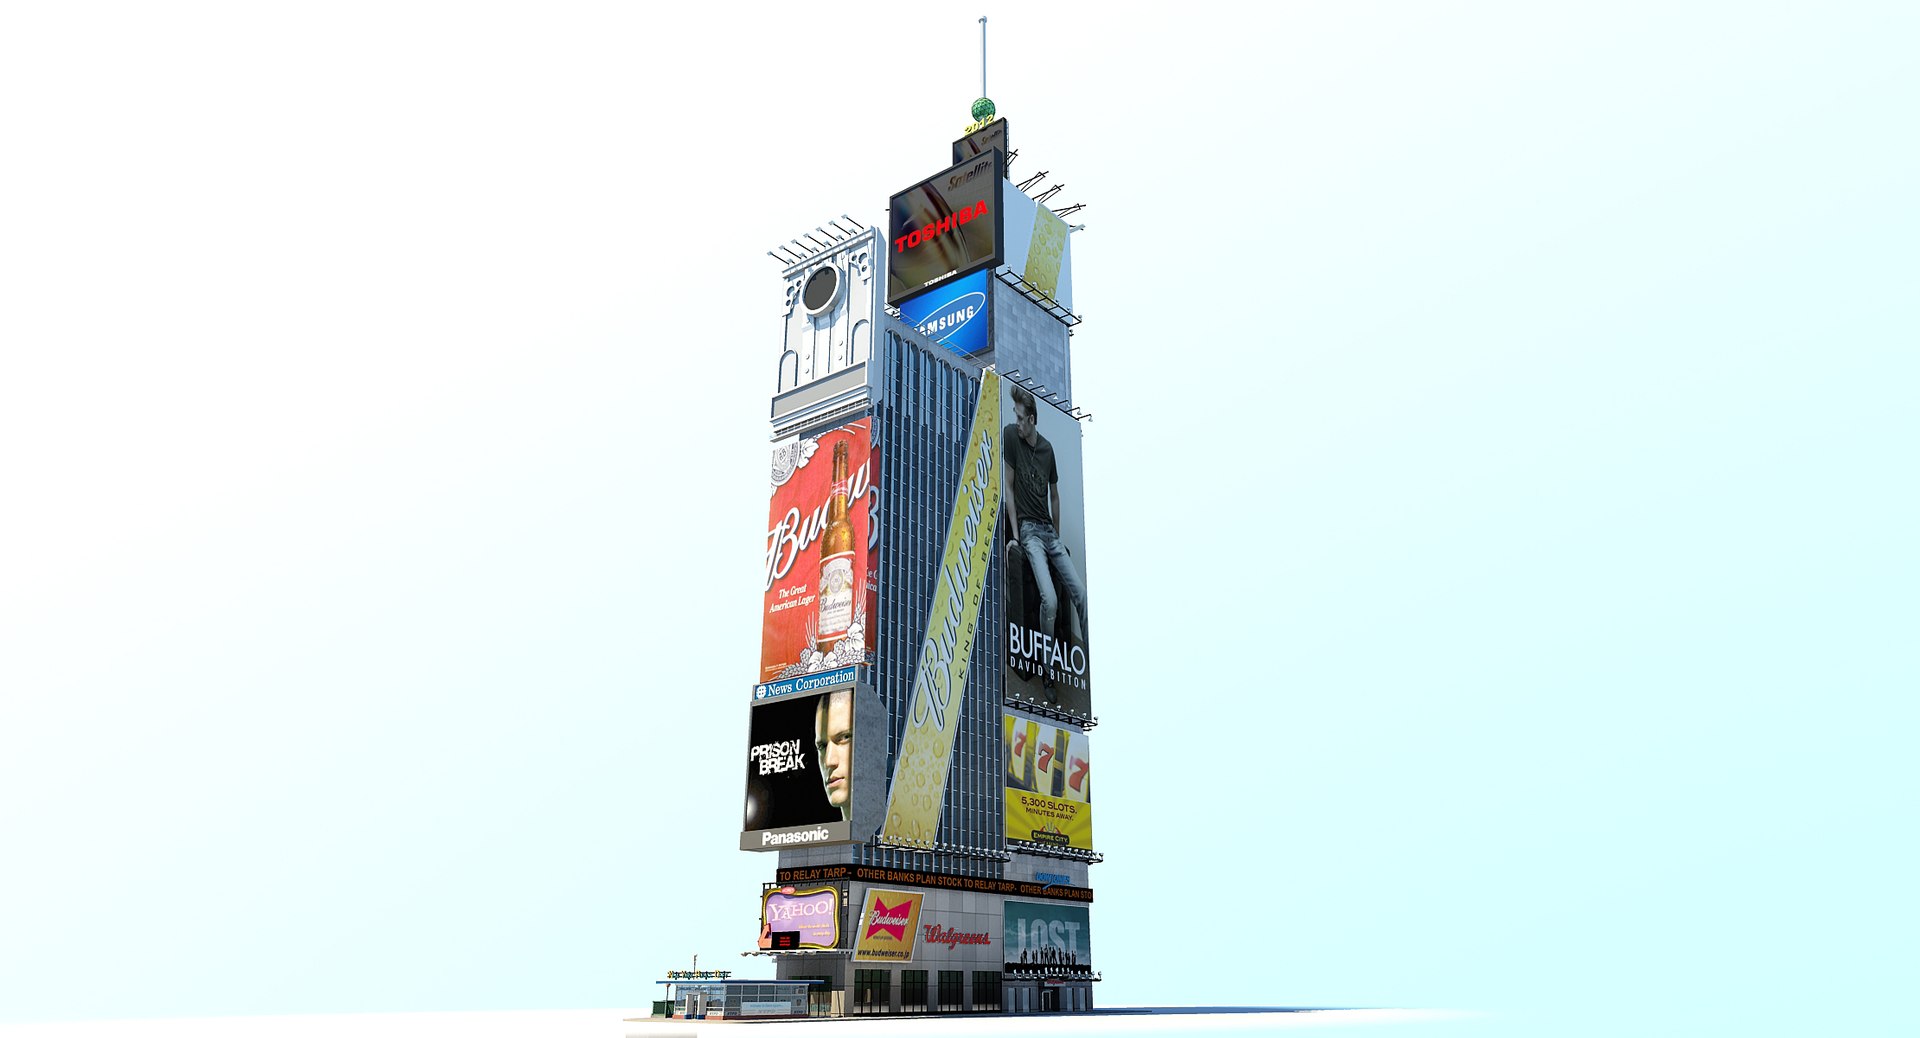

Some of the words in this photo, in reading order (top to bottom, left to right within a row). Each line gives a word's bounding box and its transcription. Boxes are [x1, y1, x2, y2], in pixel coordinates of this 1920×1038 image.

[964, 114, 995, 136] 2012
[894, 199, 988, 253] TOSHIBA
[924, 269, 958, 287] TOSHIBA
[914, 305, 974, 337] AMSUNG
[779, 588, 790, 599] The
[790, 583, 807, 596] Great
[912, 429, 993, 732] Budweiser
[958, 623, 974, 680] KING
[972, 578, 983, 606] OF
[980, 493, 999, 563] BEERS
[769, 600, 798, 613] American
[797, 594, 816, 607] Lager
[1009, 622, 1086, 676] BUFFALO
[767, 682, 793, 698] News
[795, 670, 855, 691] Corporation
[1010, 655, 1043, 677] DAVID
[1050, 669, 1086, 690] BITTON
[750, 739, 800, 763] PRISON
[759, 753, 806, 776] BREAK
[1038, 742, 1054, 774] 7
[1069, 755, 1089, 793] 7
[1021, 796, 1046, 808] 5,300
[1025, 807, 1055, 818] MINUTES
[762, 826, 829, 846] Panasonic
[779, 871, 791, 881] TO
[793, 868, 822, 879] RELAY
[857, 868, 885, 880] OTHER
[887, 871, 915, 882] BANKS
[915, 873, 936, 885] PLAN
[937, 876, 963, 887] STOCK
[963, 878, 974, 888] TO
[974, 879, 996, 890] RELAY
[1020, 884, 1041, 895] OTHER
[1064, 889, 1079, 899] PLAN
[768, 898, 834, 922] YAHOO!
[868, 910, 909, 926] Budweiser
[924, 924, 991, 950] Walgreens
[1018, 918, 1080, 964] LOST
[857, 948, 910, 960] www.budweiser.co.jp
